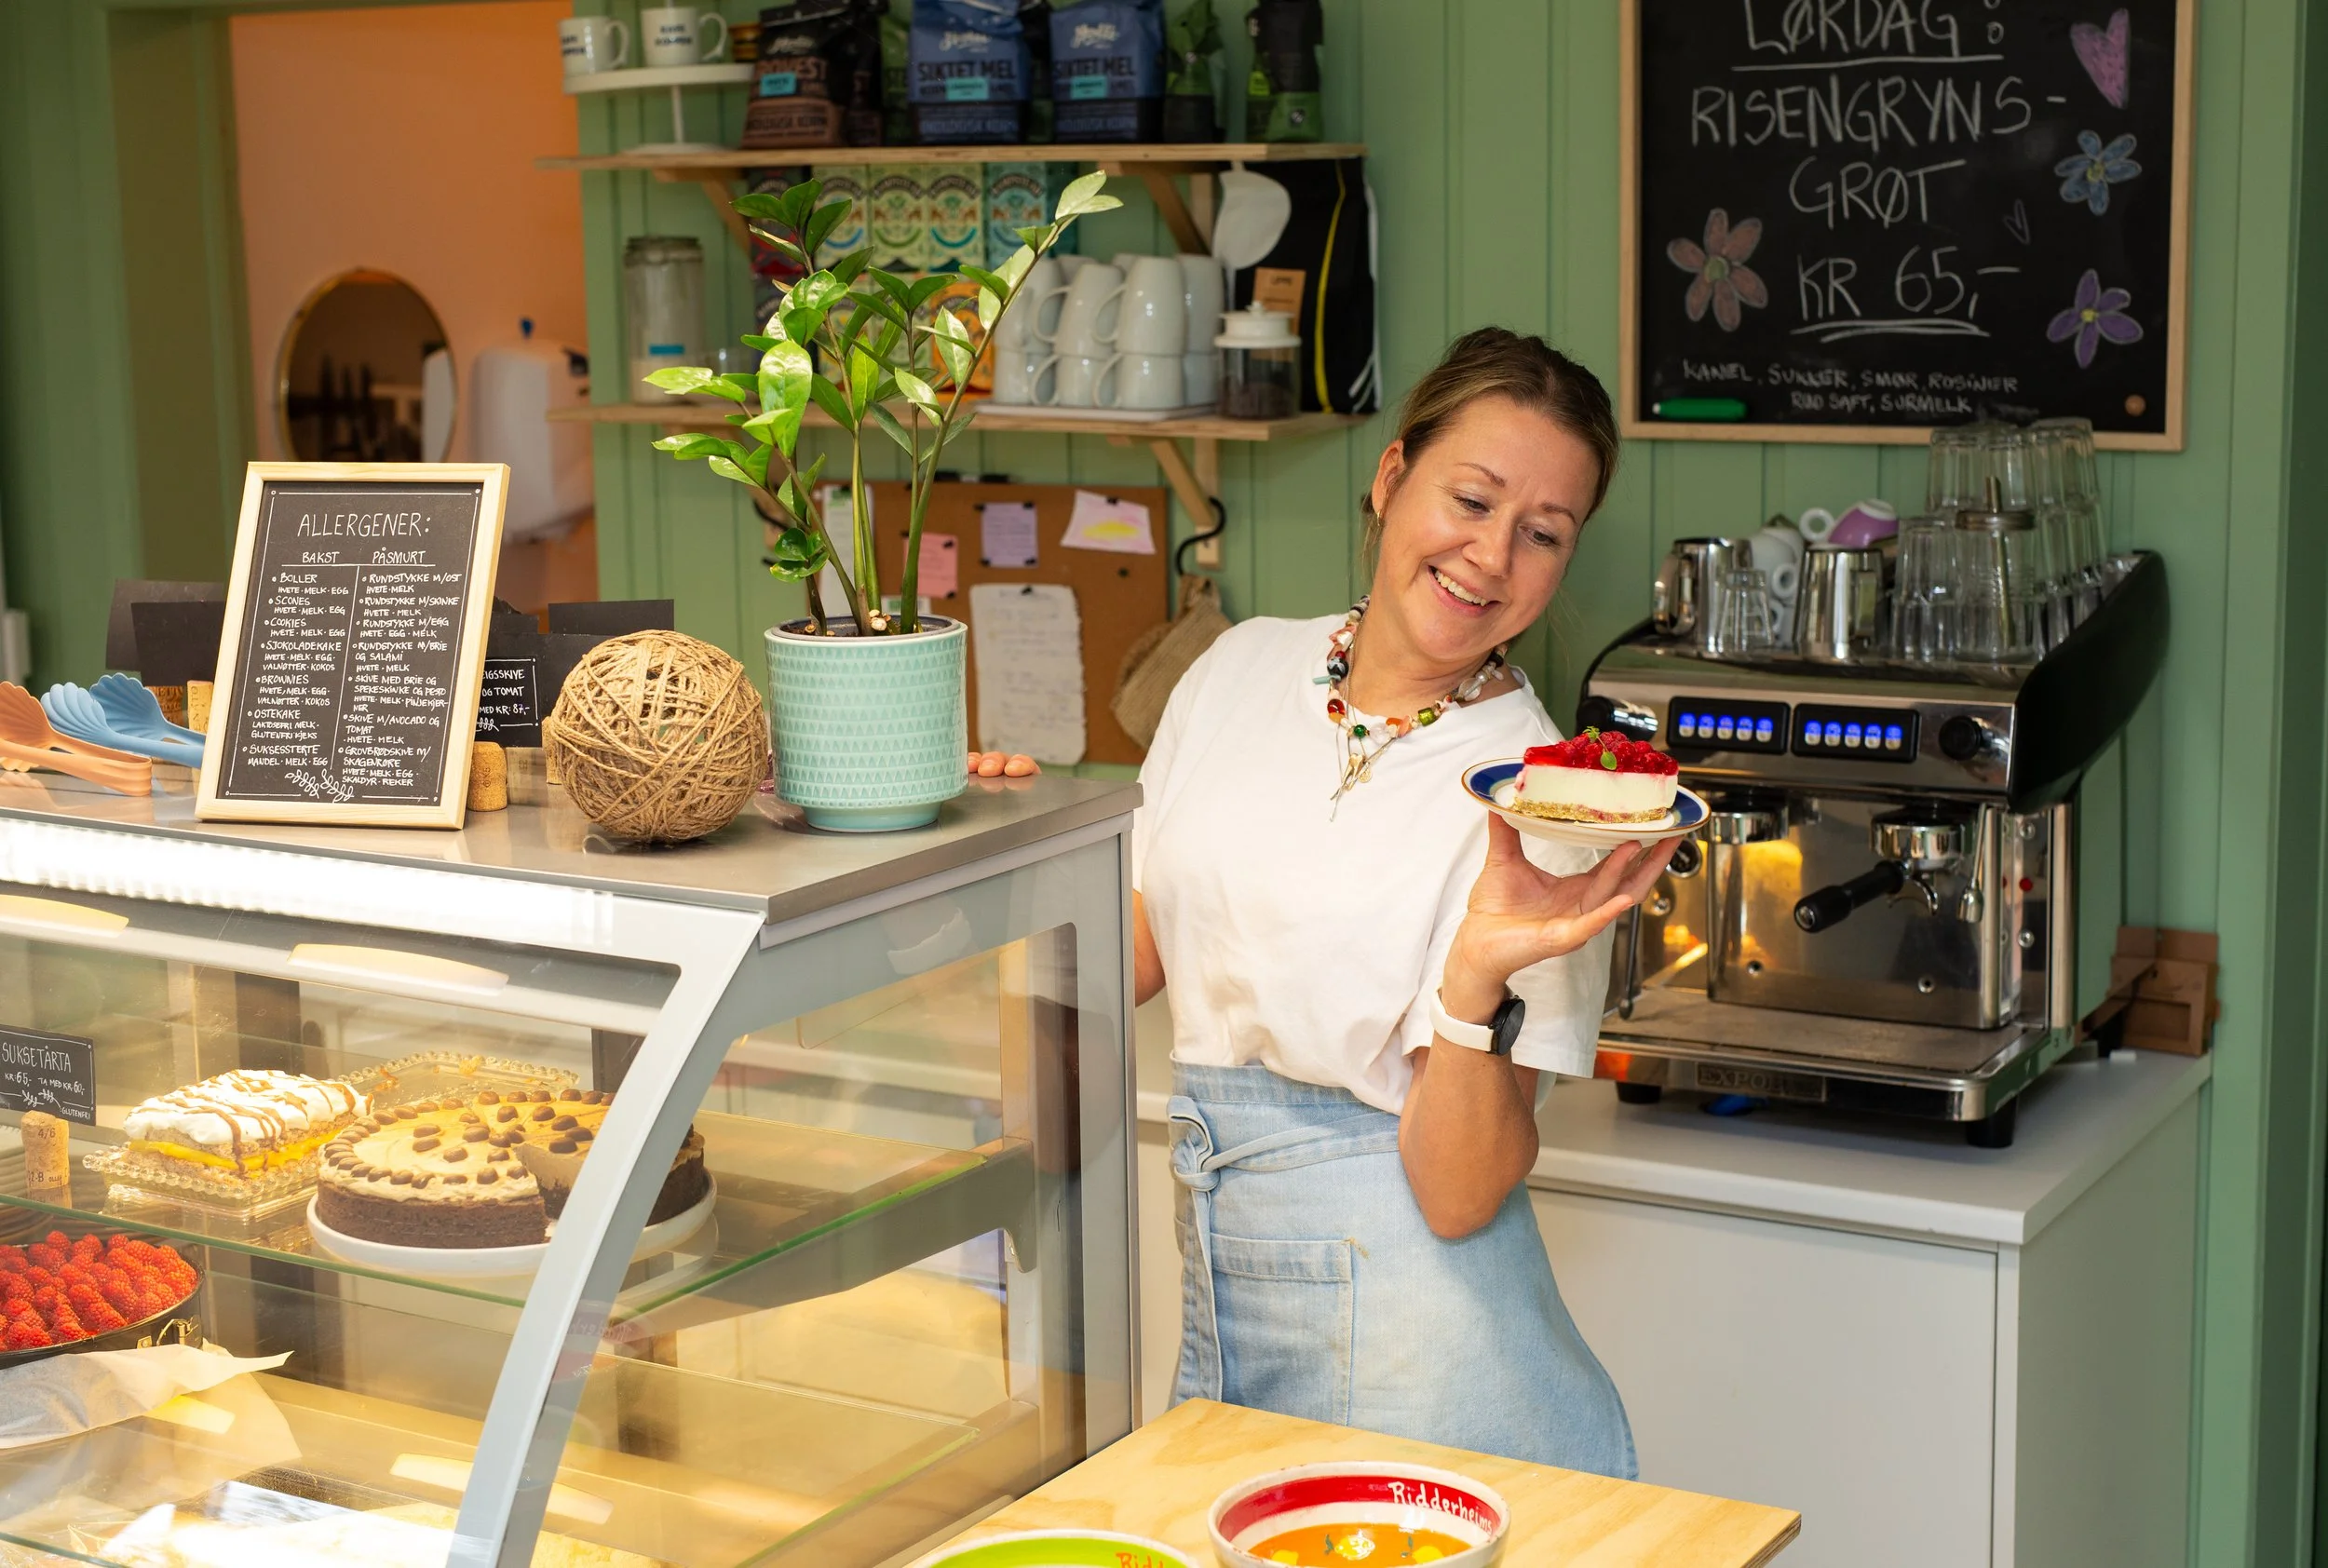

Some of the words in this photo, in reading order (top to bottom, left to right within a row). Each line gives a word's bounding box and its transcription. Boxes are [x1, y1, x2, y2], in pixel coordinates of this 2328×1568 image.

[1789, 155, 1966, 229] GRØT
[1798, 254, 1861, 320] KR
[297, 513, 431, 537] ALLERGENER:
[303, 551, 340, 563] BAKST
[372, 547, 426, 564] PÅSMURT
[280, 573, 318, 583] BOLLER
[370, 573, 429, 583] RUNDSTYKKE
[366, 586, 387, 594] HVETE
[391, 585, 414, 593] MELK
[275, 596, 310, 605] SCONES
[365, 597, 415, 606] RUNDSTYKKE
[330, 606, 345, 615] EGG
[270, 617, 306, 628] COOKIES
[363, 619, 415, 629] RUNDSTYKKE
[266, 641, 341, 651] SJOKOLADEKAKE
[359, 642, 413, 652] RUNDSTYKKE
[356, 653, 365, 662] OG
[262, 674, 309, 684] BROWNIES
[382, 676, 400, 684] MED
[426, 677, 436, 685] OG
[413, 687, 423, 696] OG
[426, 687, 446, 696] PESTO
[494, 686, 524, 696] TOMAT
[258, 696, 299, 705] VALNØTTER
[354, 704, 368, 712] NER
[254, 709, 301, 719] OSTEKAKE
[348, 714, 373, 723] SKIVE
[429, 717, 440, 727] OG
[345, 726, 374, 735] TOMAT
[250, 745, 320, 756] SUKSESSTERTE
[248, 758, 279, 766] MANDEL
[286, 758, 307, 766] MELK
[396, 769, 413, 777] EGG
[342, 776, 377, 786] SKALDYR
[2, 1042, 71, 1073] SUKSETÅRTA
[50, 1079, 62, 1088] MED
[62, 1107, 90, 1119] GLUTENFRI
[38, 1128, 56, 1140] 4/6
[1387, 1481, 1493, 1535] Ridderheims
